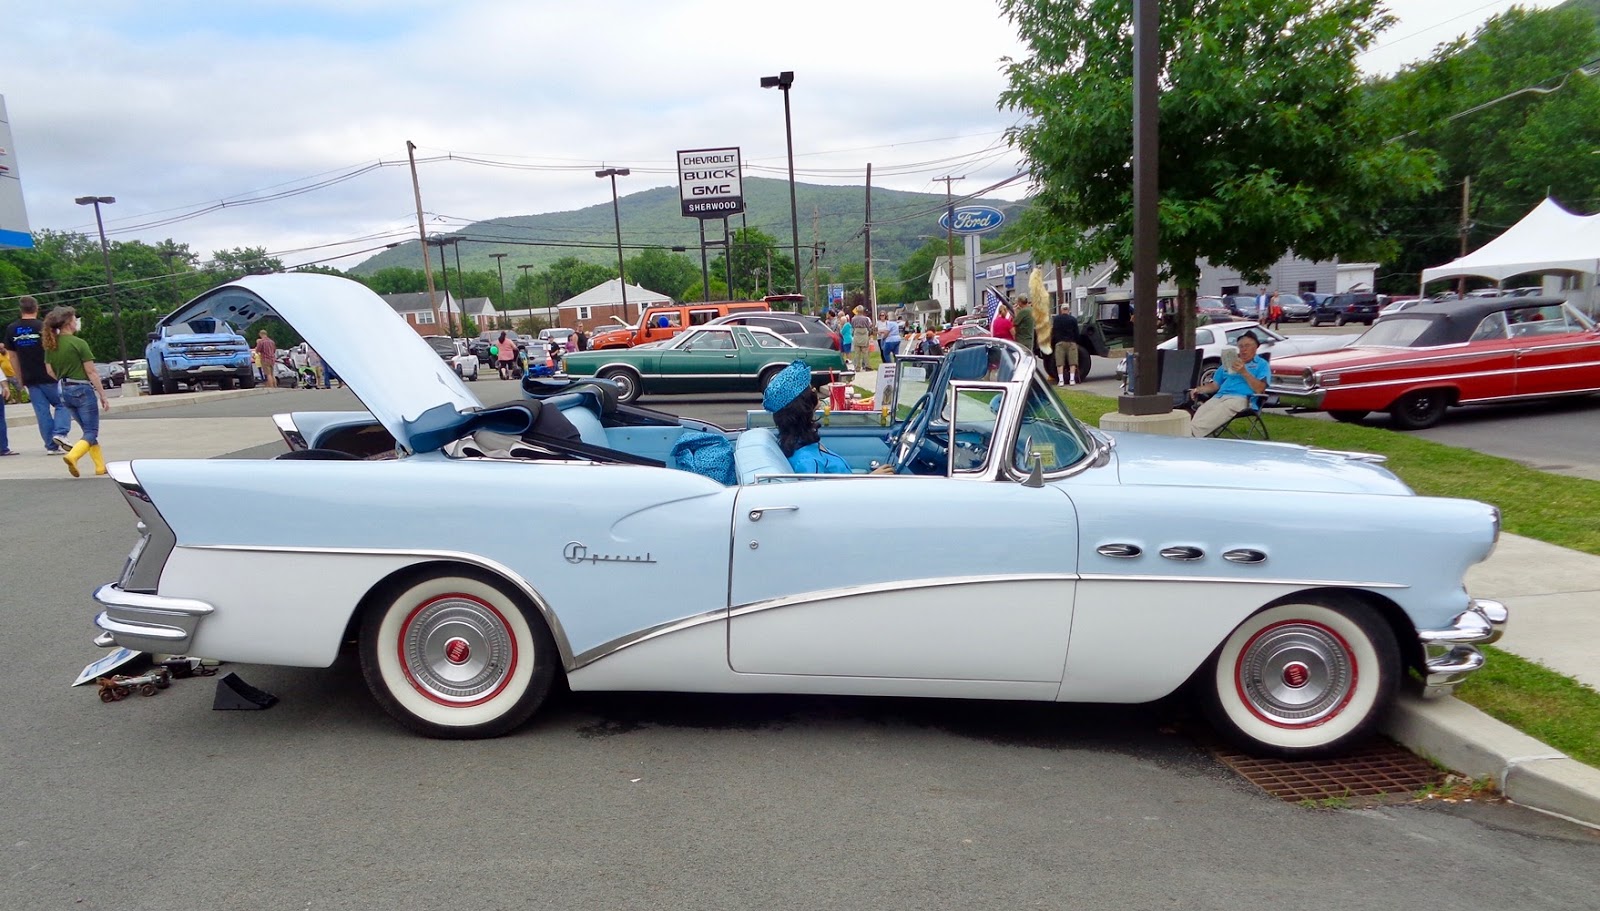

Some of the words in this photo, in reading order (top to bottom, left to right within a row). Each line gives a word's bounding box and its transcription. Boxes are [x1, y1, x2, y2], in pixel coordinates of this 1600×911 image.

[683, 154, 735, 166] CHEVROLET
[684, 169, 736, 181] BUICK
[692, 184, 731, 196] GMC
[688, 201, 737, 212] SHERWOOD
[953, 211, 992, 229] Ford
